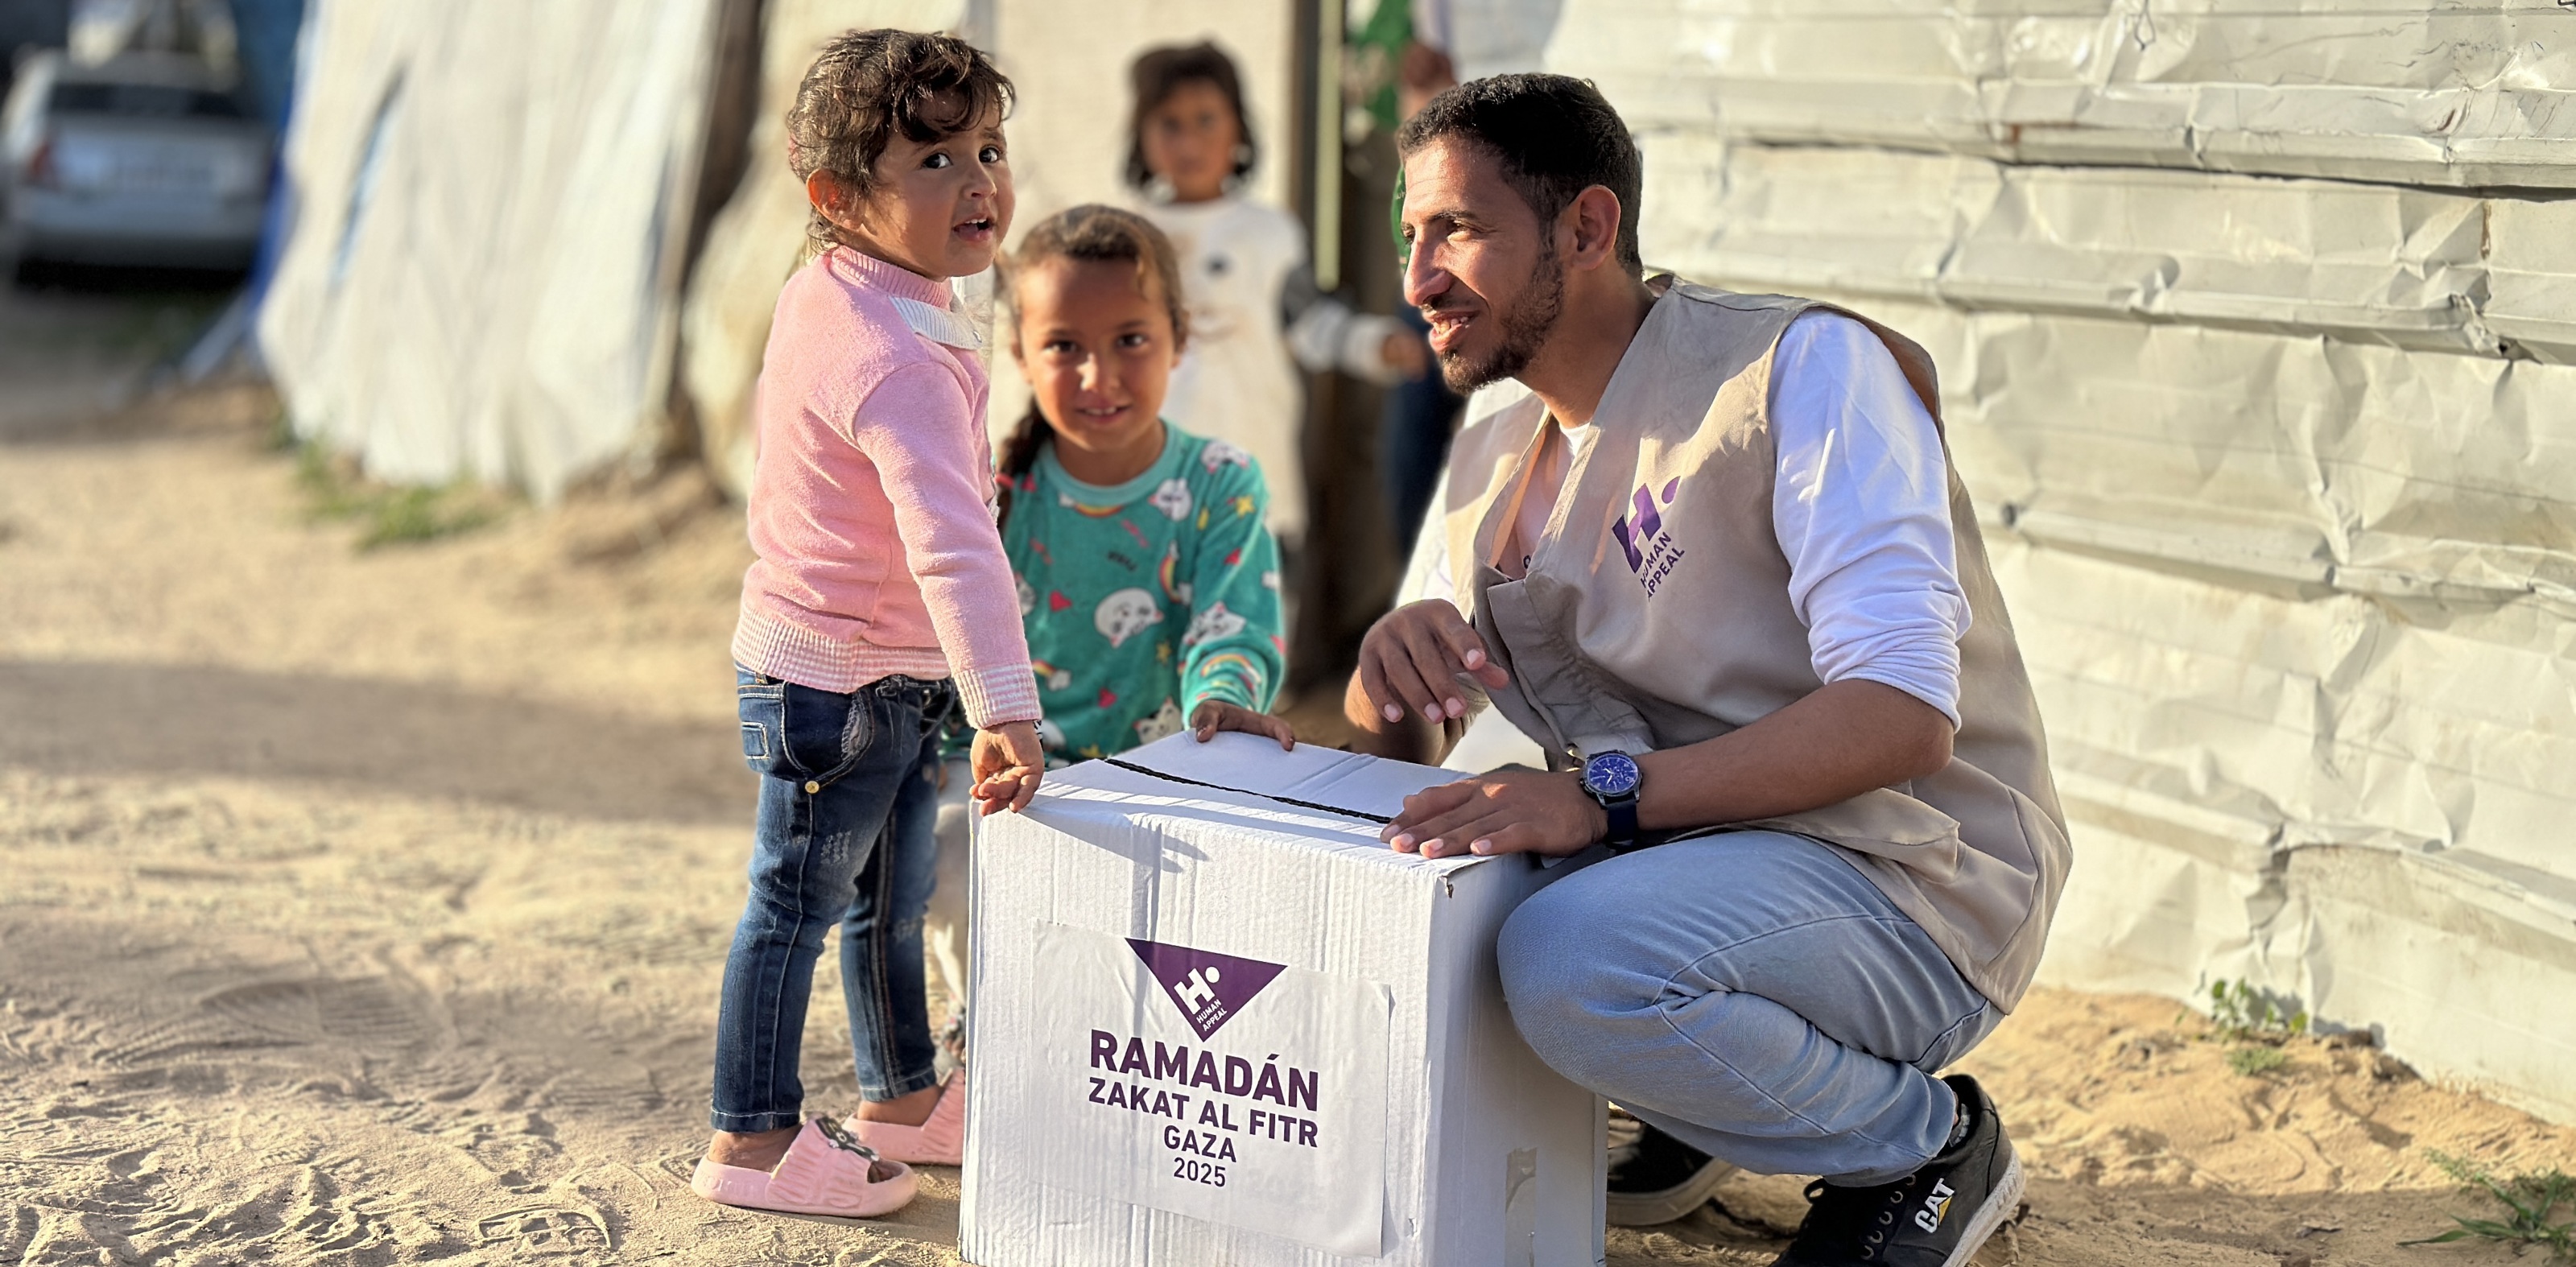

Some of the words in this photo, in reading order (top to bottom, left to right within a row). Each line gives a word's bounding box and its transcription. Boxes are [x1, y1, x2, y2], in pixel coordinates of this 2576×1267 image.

[1196, 999, 1222, 1024] HUMAN
[1202, 1007, 1228, 1032] APPEAL
[1091, 1029, 1319, 1112] RAMADÁN
[1088, 1077, 1190, 1120] ZAKAT
[1199, 1101, 1239, 1132] AL
[1249, 1110, 1319, 1148] FITR
[1163, 1125, 1237, 1162] GAZA
[1173, 1157, 1227, 1187] 2025
[1915, 1178, 1955, 1233] CAT
